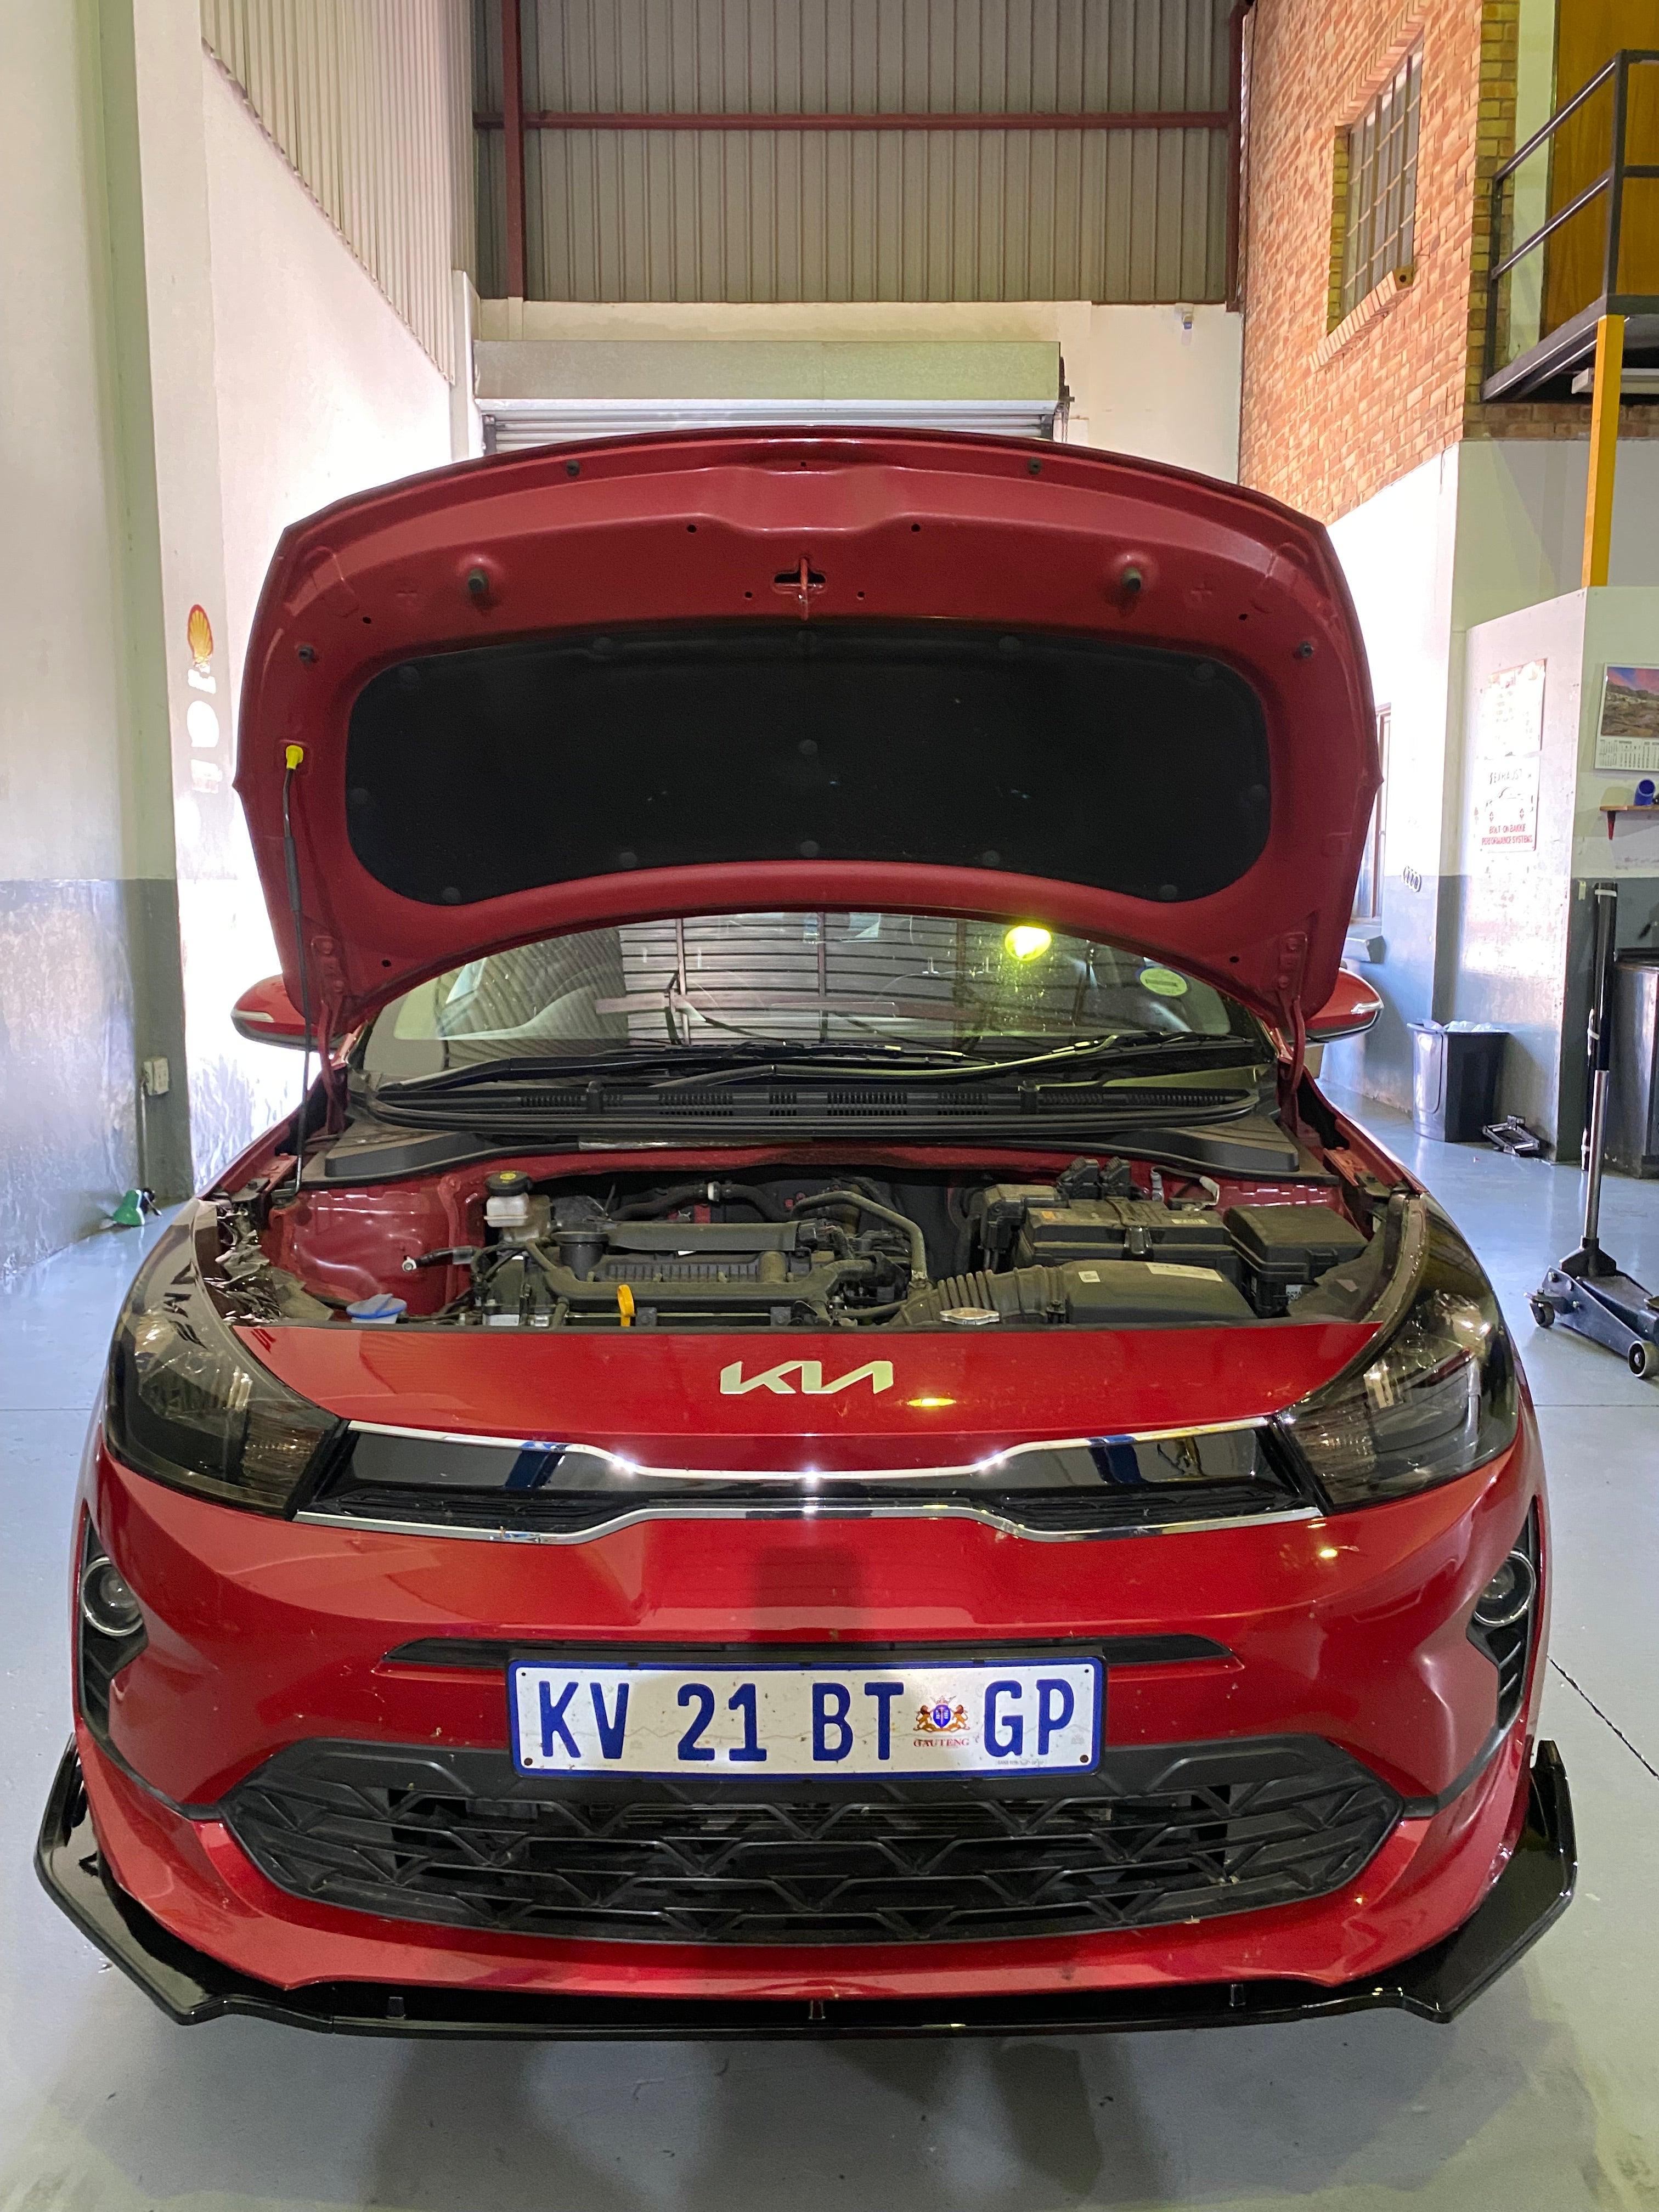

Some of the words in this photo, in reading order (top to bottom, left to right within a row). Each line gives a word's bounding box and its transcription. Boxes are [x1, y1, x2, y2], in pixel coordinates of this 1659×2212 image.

[720, 1360, 894, 1394] KIA
[539, 1680, 630, 1759] KV
[677, 1682, 768, 1762] 21
[812, 1681, 904, 1761] BT
[984, 1679, 1074, 1758] GP
[913, 1738, 969, 1747] GAUTENG
